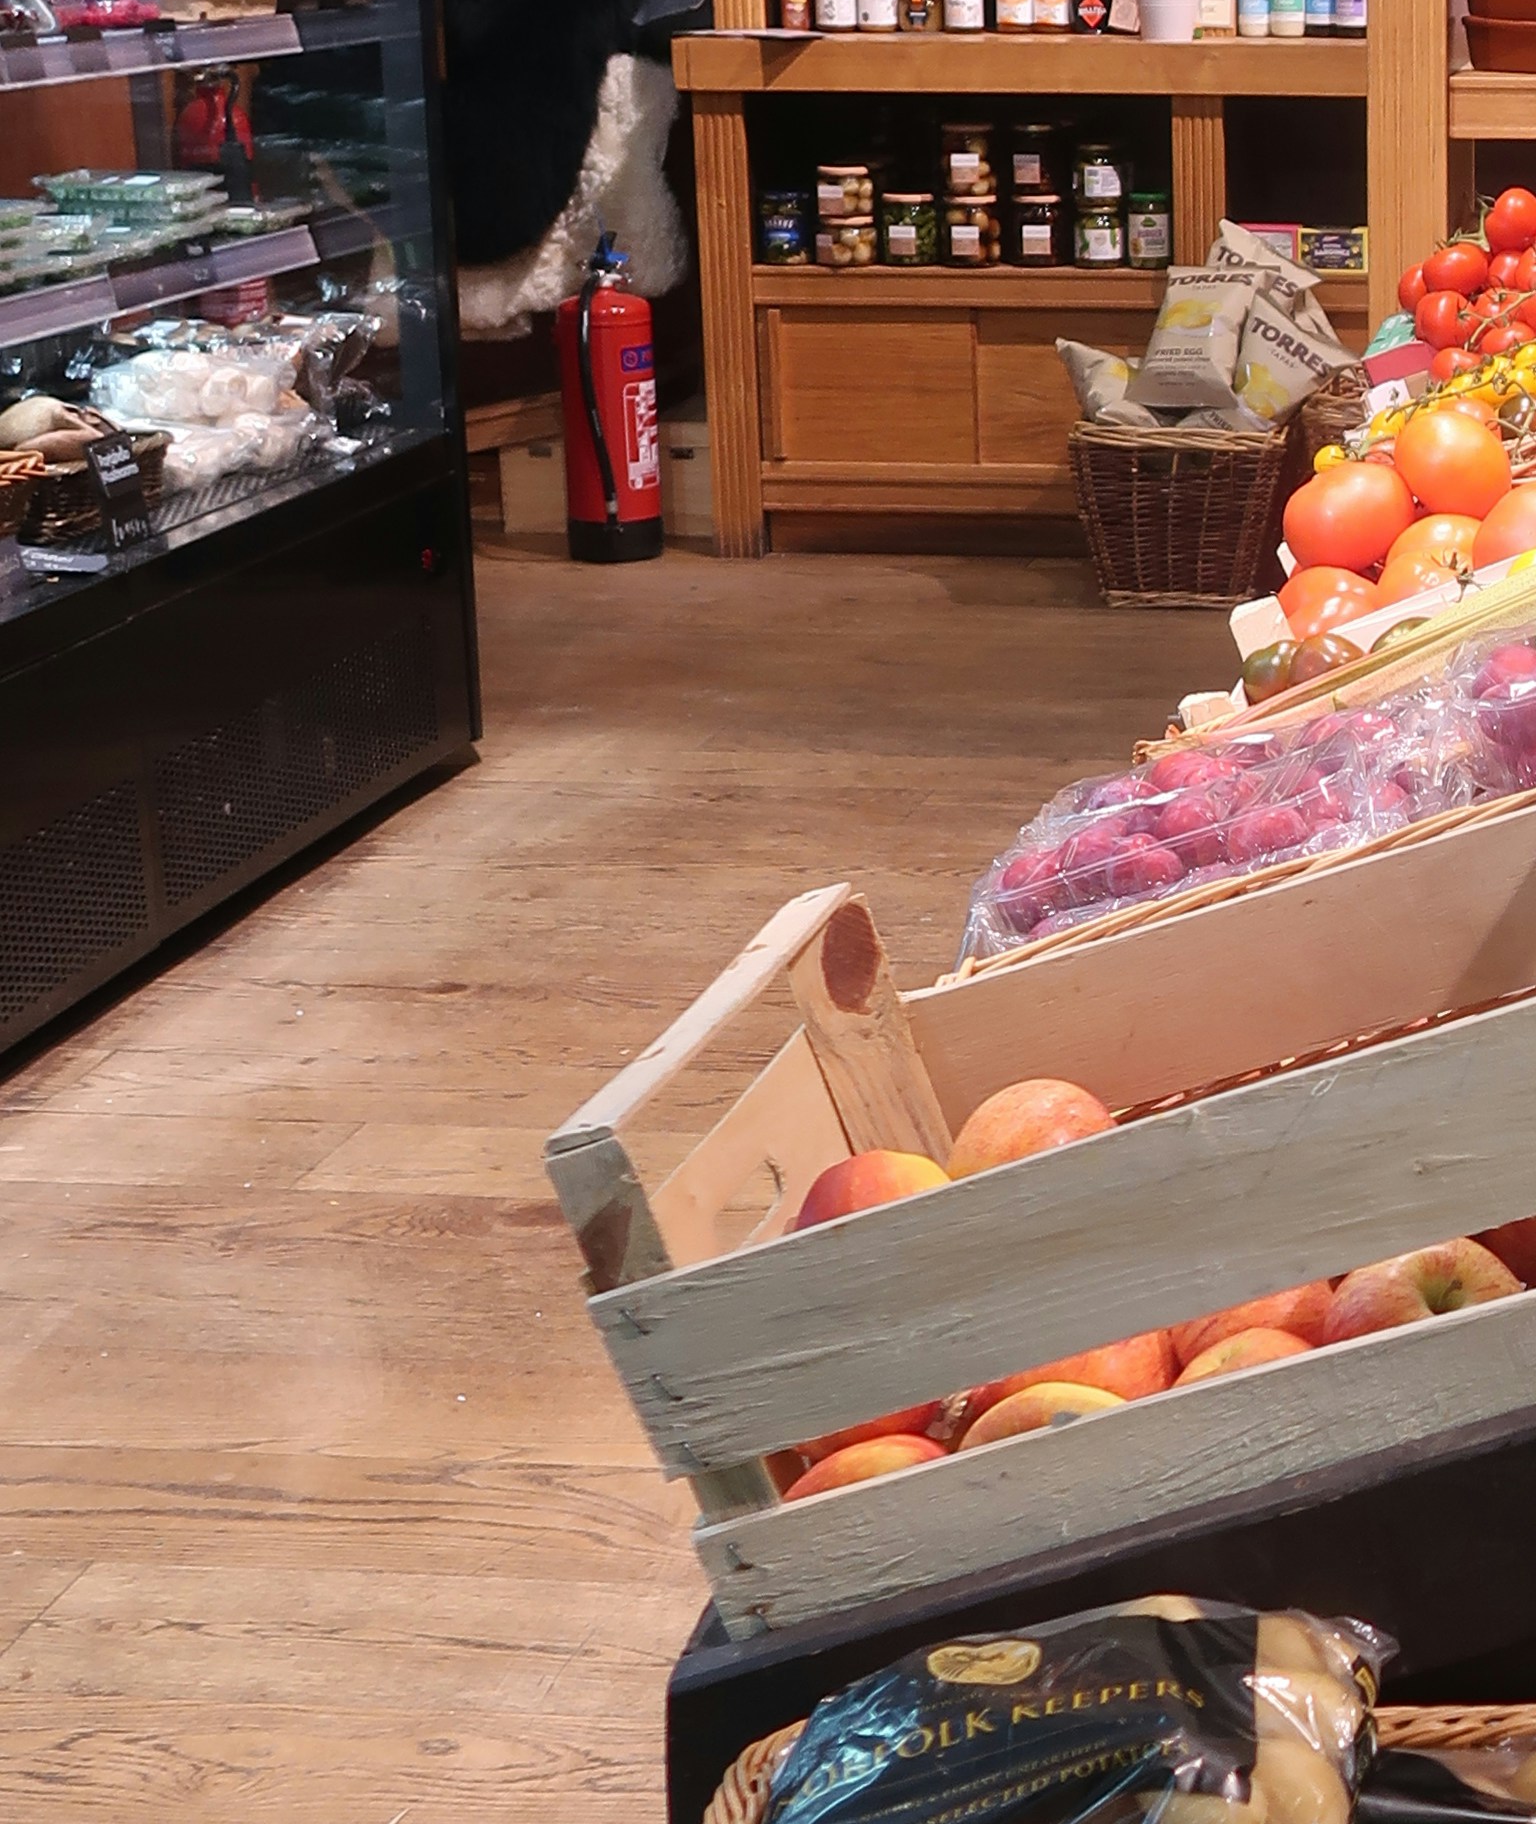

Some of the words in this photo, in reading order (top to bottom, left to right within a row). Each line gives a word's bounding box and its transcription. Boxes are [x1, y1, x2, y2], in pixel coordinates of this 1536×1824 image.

[1169, 273, 1254, 287] TORRES
[1155, 348, 1182, 356] FRIED
[1183, 347, 1203, 356] EGG
[1251, 317, 1334, 378] TORRES
[779, 1707, 998, 1806] ORFOLK
[1010, 1679, 1206, 1726] KEEPERS
